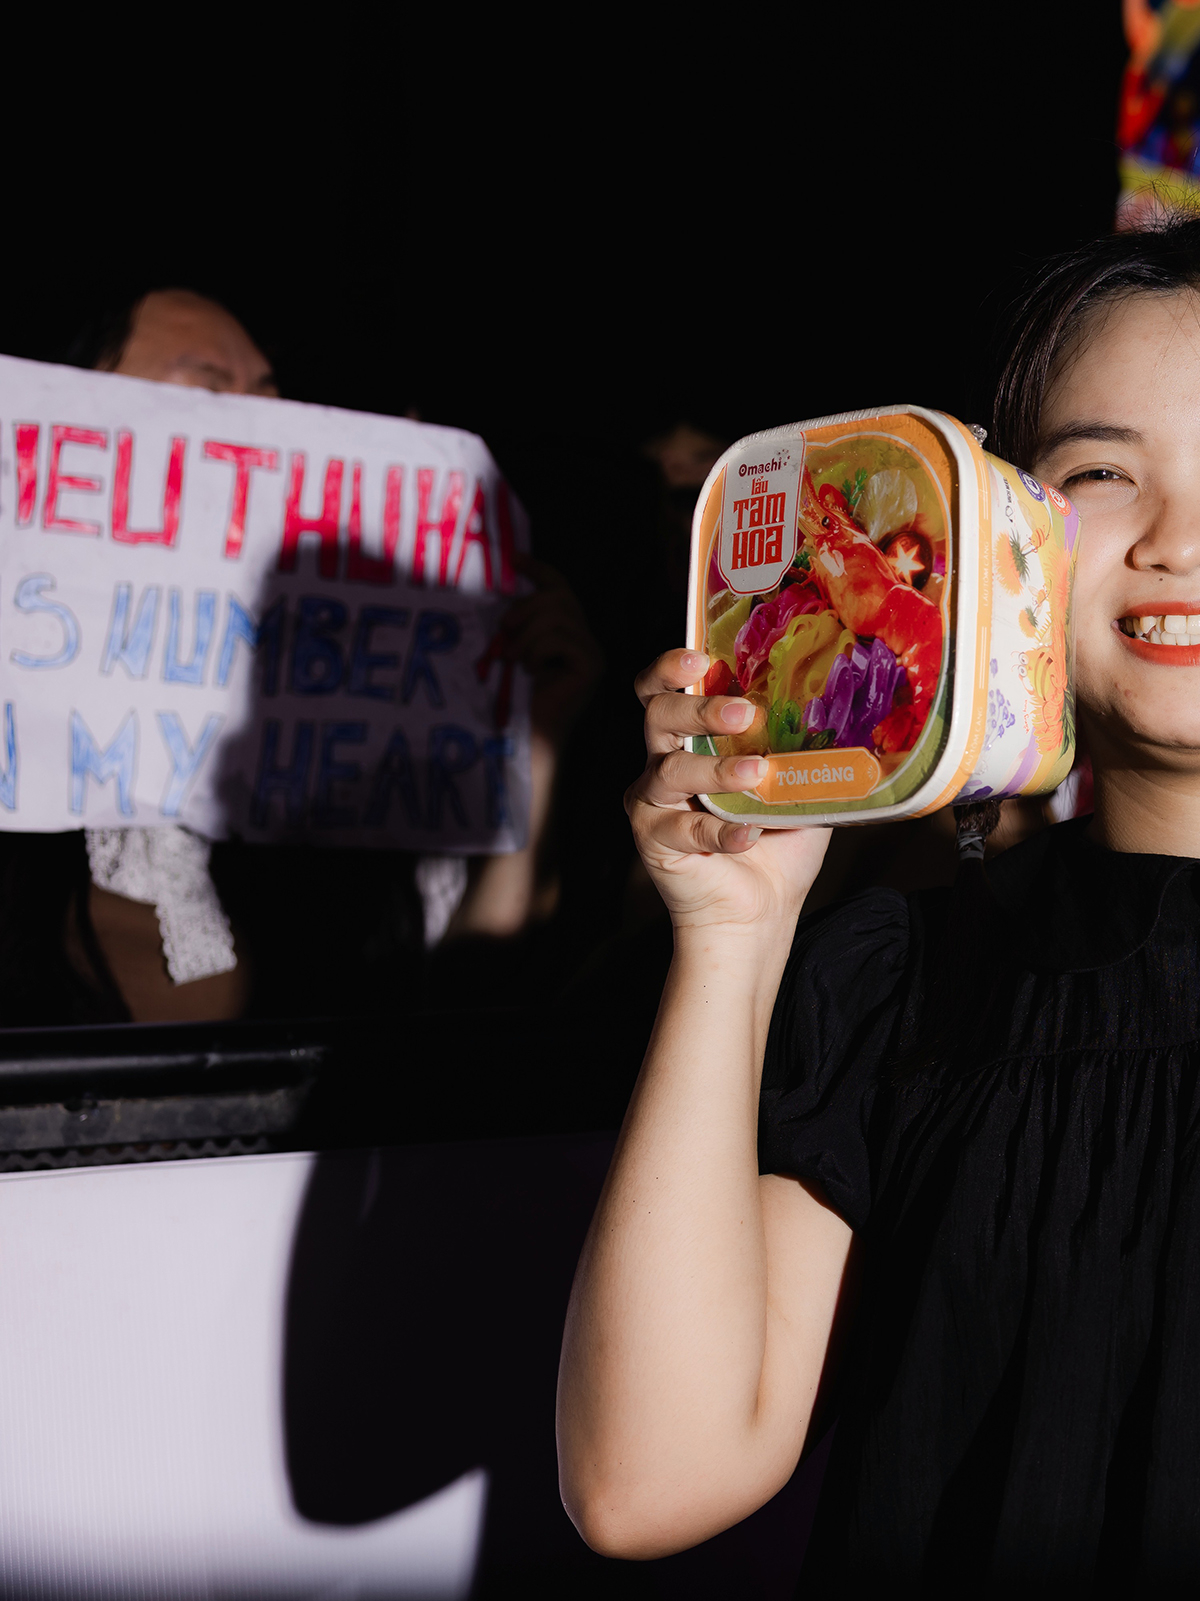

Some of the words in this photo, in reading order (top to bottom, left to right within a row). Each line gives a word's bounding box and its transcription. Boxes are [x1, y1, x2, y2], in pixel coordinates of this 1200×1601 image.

[10, 421, 519, 595] IEUTHUHAI
[738, 456, 782, 477] Omachi
[100, 581, 460, 707] NUMBER
[70, 707, 226, 818] MY
[249, 717, 516, 830] HEART
[776, 765, 809, 786] TÔM
